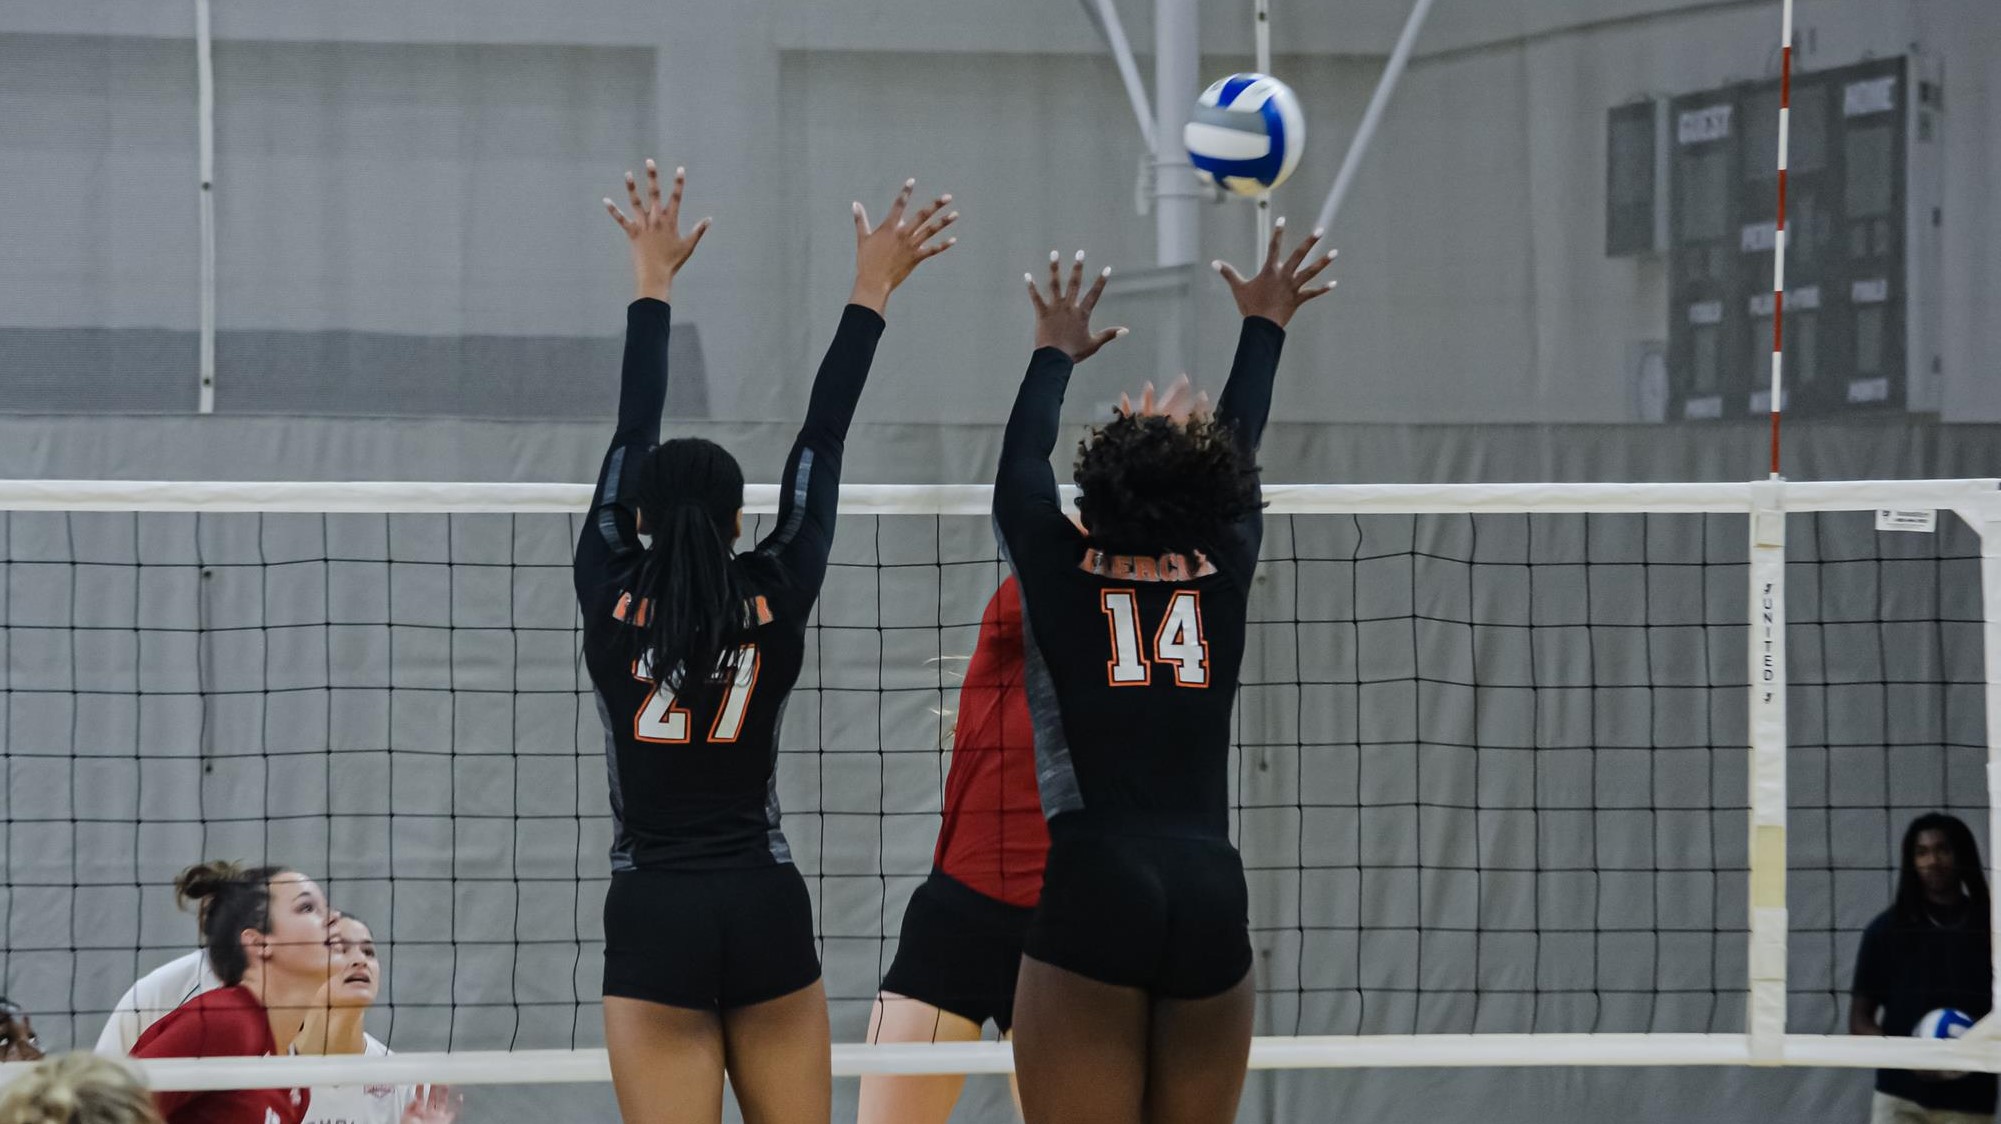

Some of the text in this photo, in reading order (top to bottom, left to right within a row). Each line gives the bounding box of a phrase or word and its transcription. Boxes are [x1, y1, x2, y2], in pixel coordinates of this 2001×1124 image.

[1101, 588, 1209, 688] 14
[1763, 597, 1774, 681] UNITED
[632, 644, 761, 743] 27
